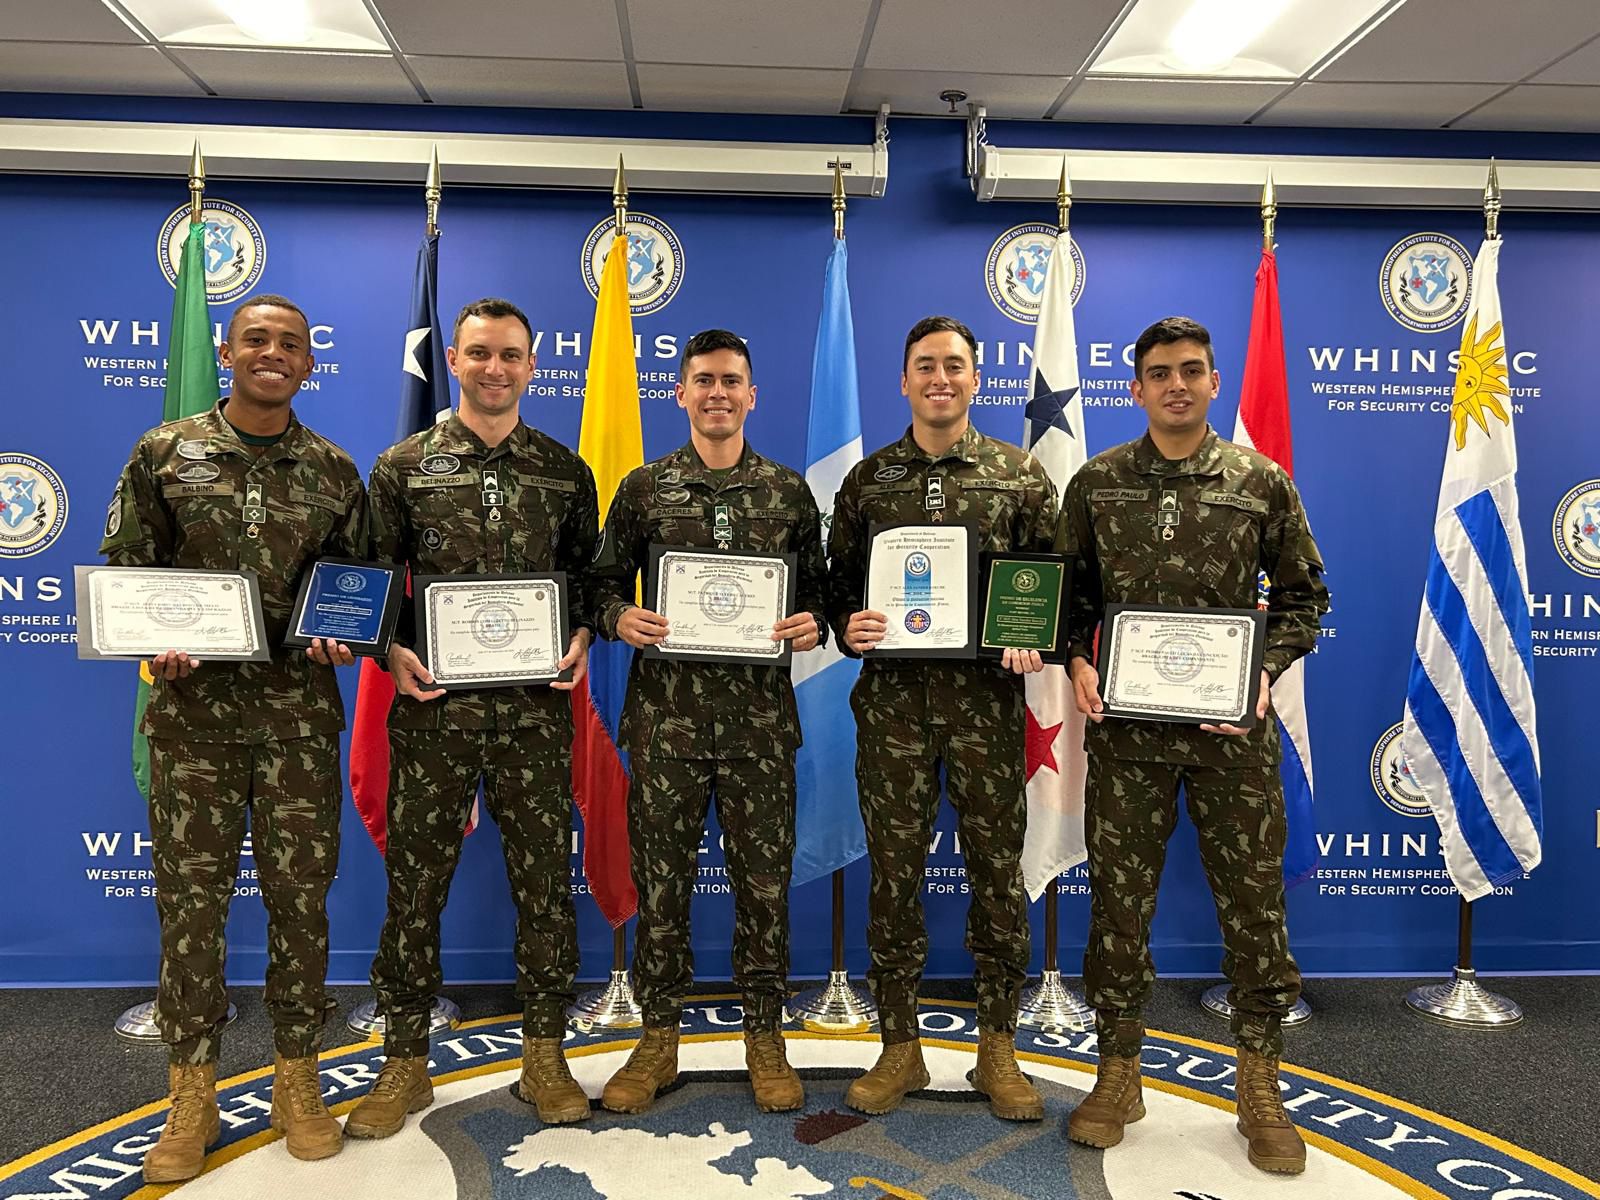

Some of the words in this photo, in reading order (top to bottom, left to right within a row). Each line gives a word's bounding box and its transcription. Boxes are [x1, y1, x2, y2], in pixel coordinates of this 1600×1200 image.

[220, 203, 236, 213] FOR
[233, 208, 259, 237] SECURITY
[641, 216, 656, 227] FOR
[160, 209, 187, 248] HEMISPHERE
[1010, 225, 1044, 238] INSTITUTE
[1043, 226, 1058, 236] FOR
[584, 223, 610, 260] HEMISPHERE
[654, 222, 678, 250] SECURITY
[246, 236, 262, 283] COOPERATION
[1382, 243, 1407, 279] HEMISPHERE
[1404, 235, 1438, 247] INSTITUTE
[1437, 236, 1451, 246] FOR
[1448, 242, 1473, 269] SECURITY
[161, 249, 176, 281] WESTERN
[585, 261, 599, 293] WESTERN
[665, 249, 681, 296] COOPERATION
[84, 356, 156, 370] WESTERN
[1308, 347, 1537, 375] WHINSC
[533, 369, 578, 380] STERN
[104, 375, 133, 388] FOR
[528, 385, 556, 397] FOR
[1311, 382, 1376, 395] WESTERN
[1328, 400, 1354, 411] FOR
[1360, 400, 1425, 413] SECURITY
[22, 456, 38, 467] FOR
[35, 462, 62, 491] SECURITY
[421, 476, 461, 486] BELINAZZO
[182, 485, 215, 494] BALBINO
[1096, 491, 1119, 499] PEDRO
[1119, 492, 1145, 500] PAULO
[47, 489, 65, 537] COOPERATION
[1533, 645, 1598, 657] SECURITY
[1372, 729, 1398, 766] HEMISPHERE
[1373, 766, 1387, 796] WESTERN
[1316, 869, 1367, 880] ESTERN
[104, 885, 135, 898] FOR
[927, 883, 955, 894] FOR
[1319, 884, 1346, 896] FOR
[1351, 884, 1416, 897] SECURITY
